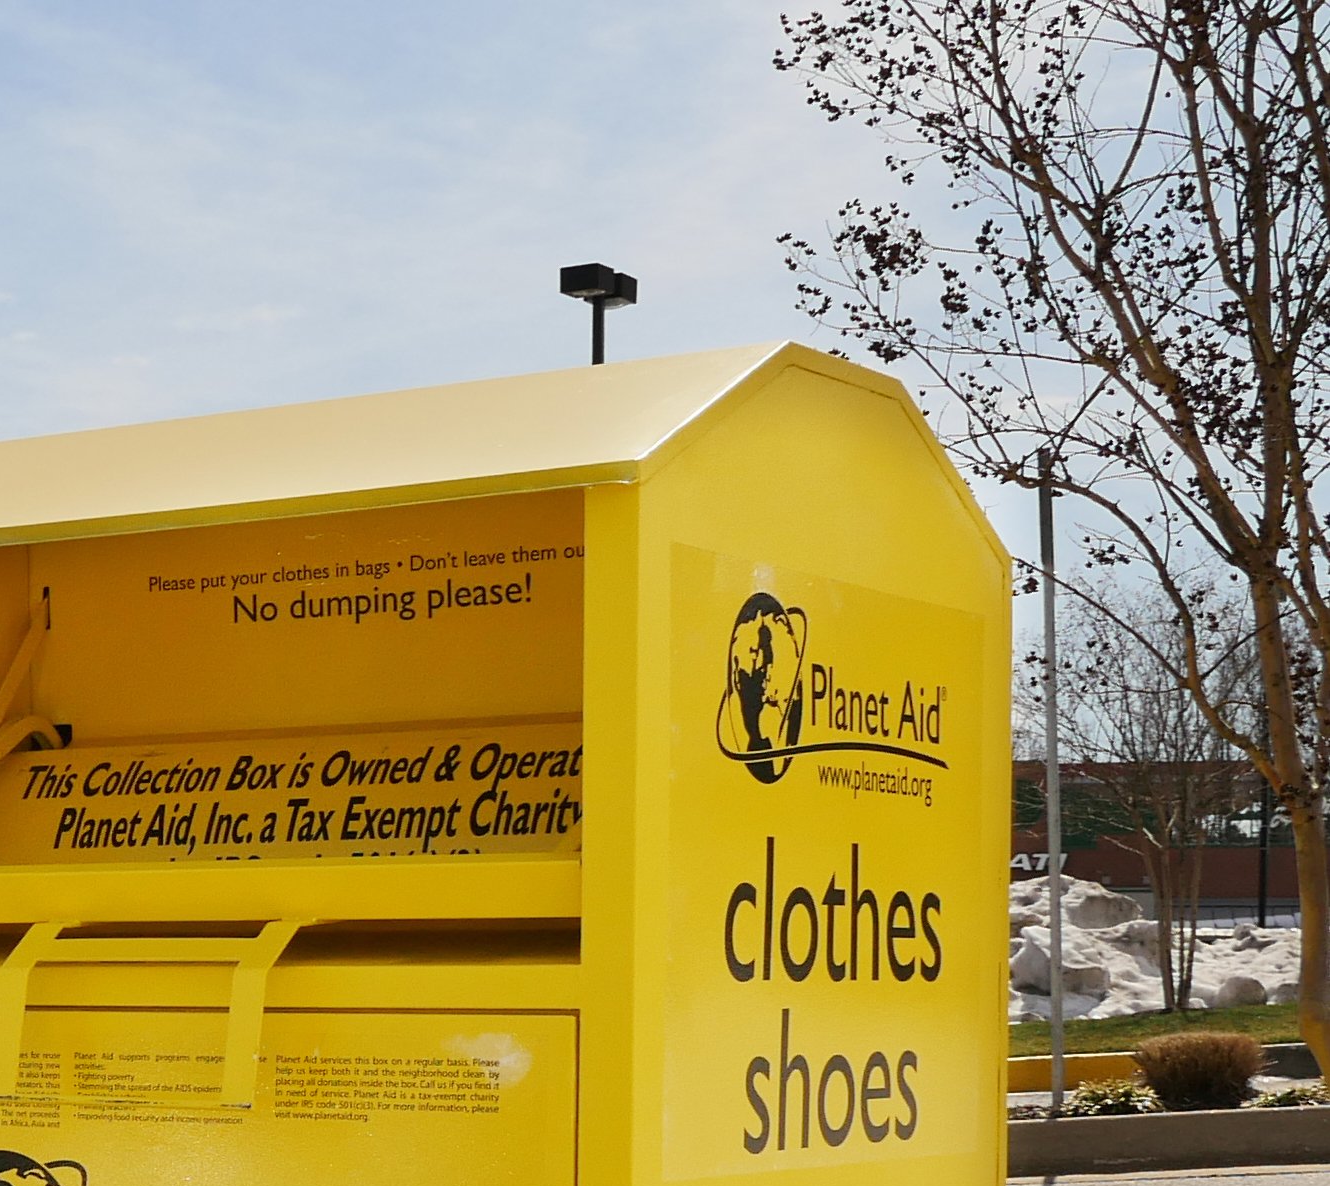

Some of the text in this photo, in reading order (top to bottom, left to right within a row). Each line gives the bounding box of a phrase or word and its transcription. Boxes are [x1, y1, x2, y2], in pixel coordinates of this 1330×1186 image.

[149, 576, 195, 592] Please
[201, 575, 226, 593] put
[231, 572, 267, 591] your
[272, 564, 330, 583] clothes
[336, 563, 349, 577] in
[355, 560, 390, 579] bags
[410, 555, 458, 572] Don't
[464, 551, 505, 567] leave
[512, 546, 557, 563] them
[233, 572, 531, 624] No dumping please!
[812, 664, 889, 737] Planet
[22, 742, 583, 801] This Collection Box is Owned & Operat
[818, 762, 932, 807] www.planetaid.org
[53, 806, 142, 850] Planet
[142, 802, 197, 856] Aid,
[203, 800, 254, 846] Inc.
[259, 812, 277, 843] a
[285, 798, 335, 843] Tax
[340, 795, 461, 853] Exempt
[725, 837, 941, 982] clothes
[275, 1055, 301, 1065] Planet
[303, 1055, 317, 1065] Aid
[319, 1056, 352, 1065] services
[355, 1056, 370, 1065] this
[372, 1056, 388, 1066] box
[391, 1058, 403, 1066] on
[413, 1057, 444, 1068] regular
[472, 1058, 500, 1068] Please
[744, 1008, 917, 1154] shoes
